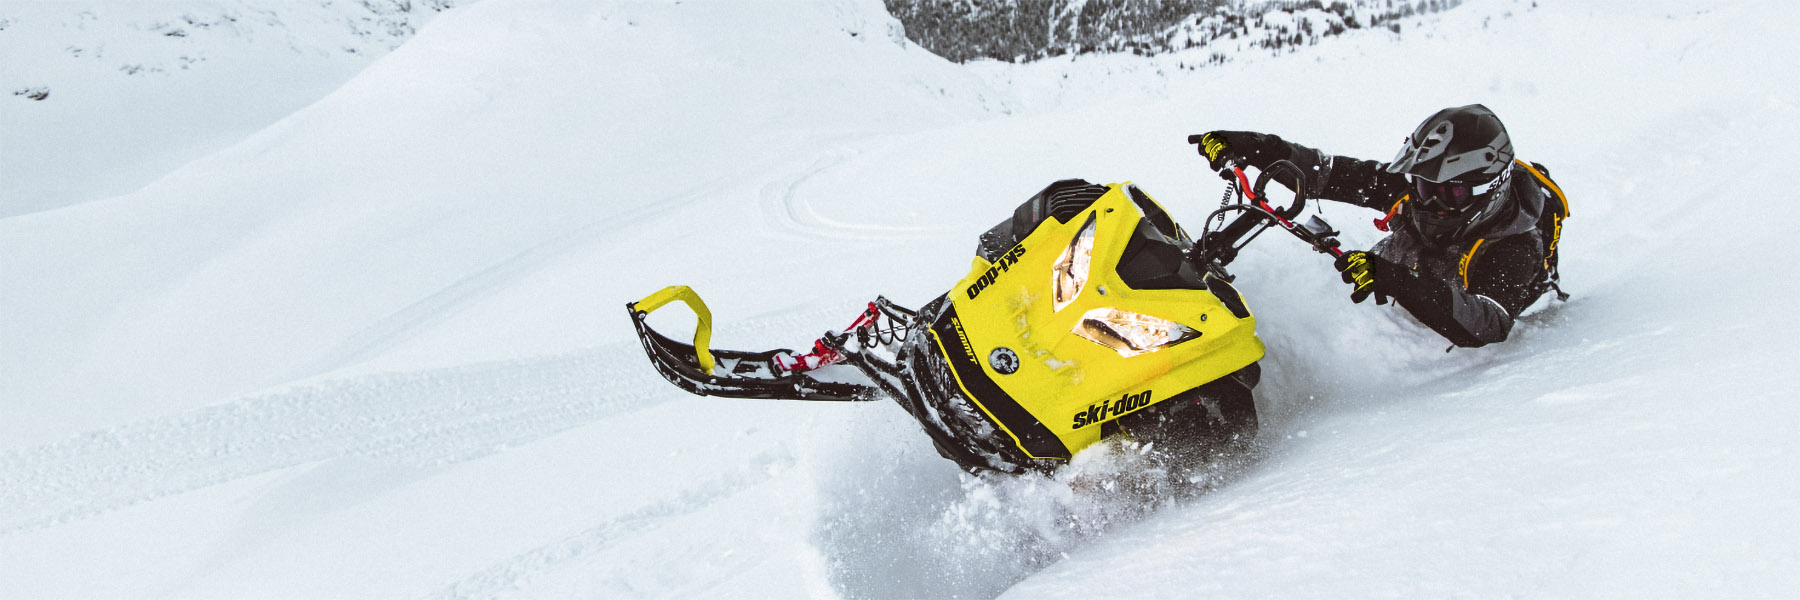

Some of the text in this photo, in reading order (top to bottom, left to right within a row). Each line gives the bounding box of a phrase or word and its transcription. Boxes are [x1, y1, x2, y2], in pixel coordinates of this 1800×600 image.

[966, 243, 1026, 300] ski-doo
[950, 316, 978, 365] SUMMIT
[1072, 389, 1153, 430] ski-doo
